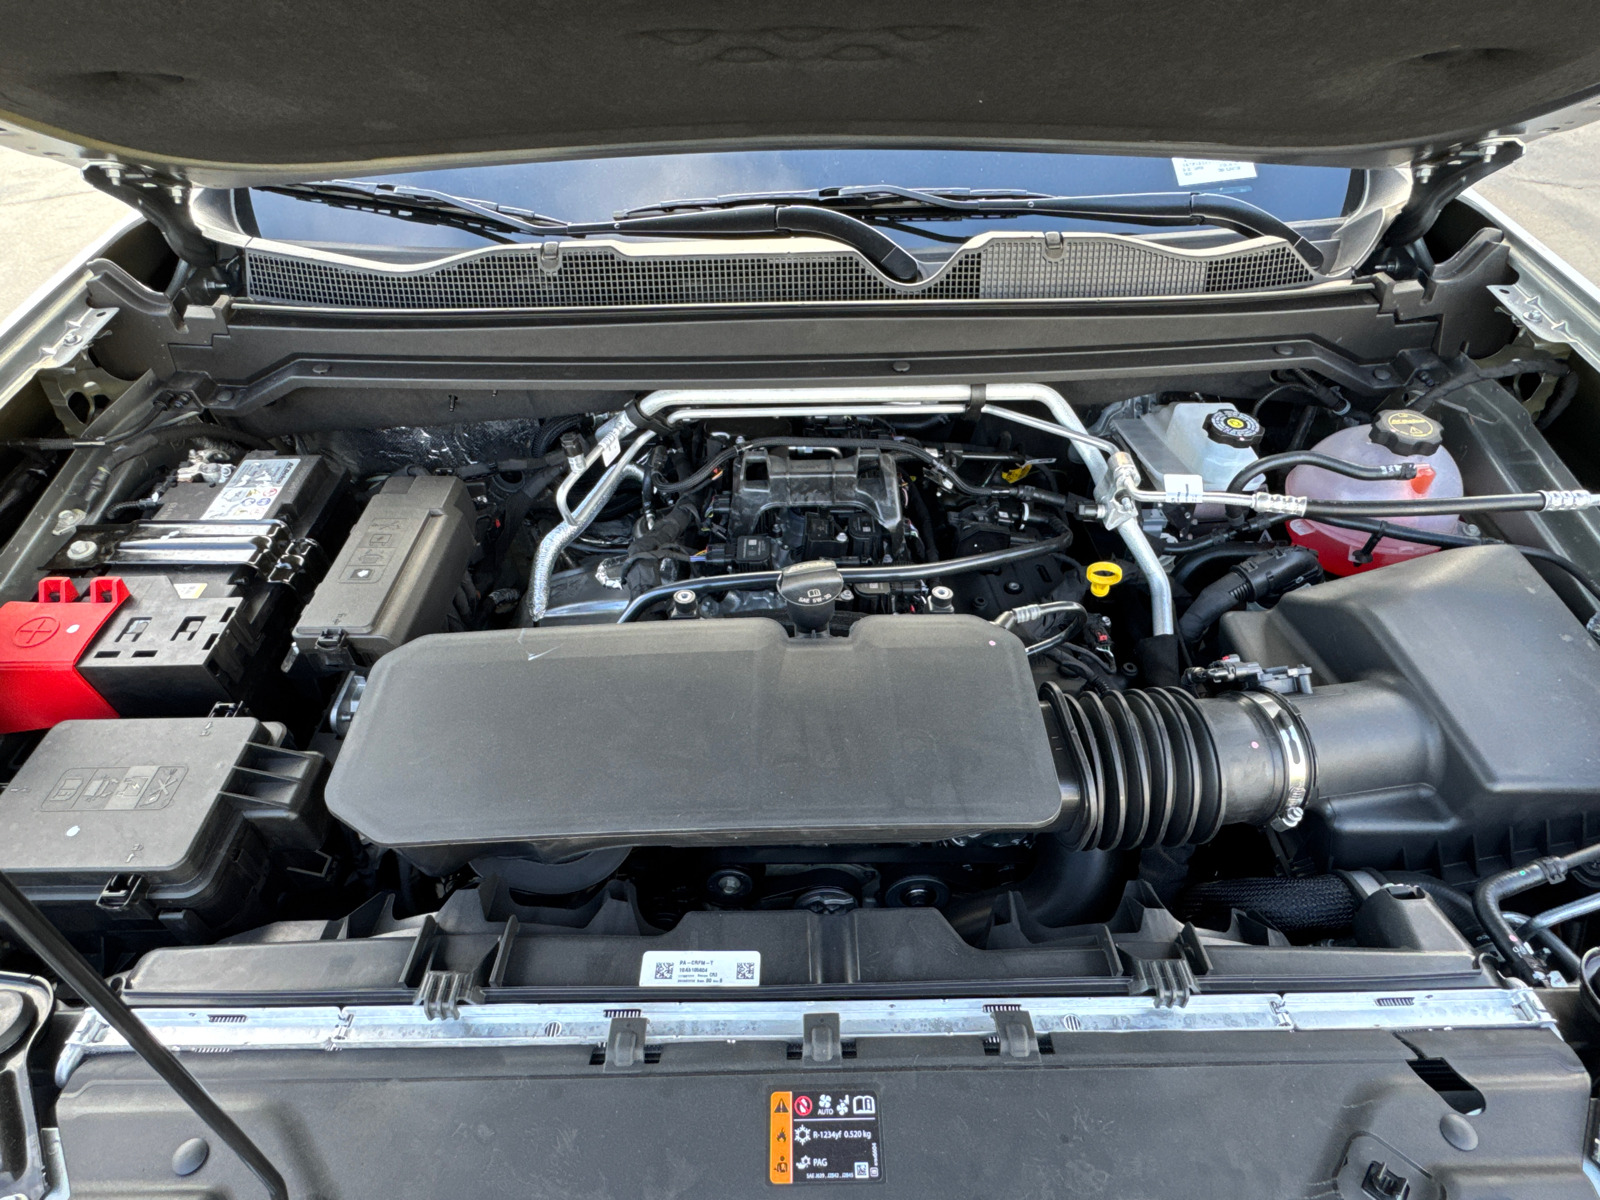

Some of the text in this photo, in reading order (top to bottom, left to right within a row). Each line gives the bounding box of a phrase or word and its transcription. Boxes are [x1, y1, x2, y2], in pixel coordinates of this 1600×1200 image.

[817, 1108, 834, 1116] AUTO
[813, 1130, 871, 1140] R-1234yf 0.520 kg
[813, 1158, 828, 1167] PAG
